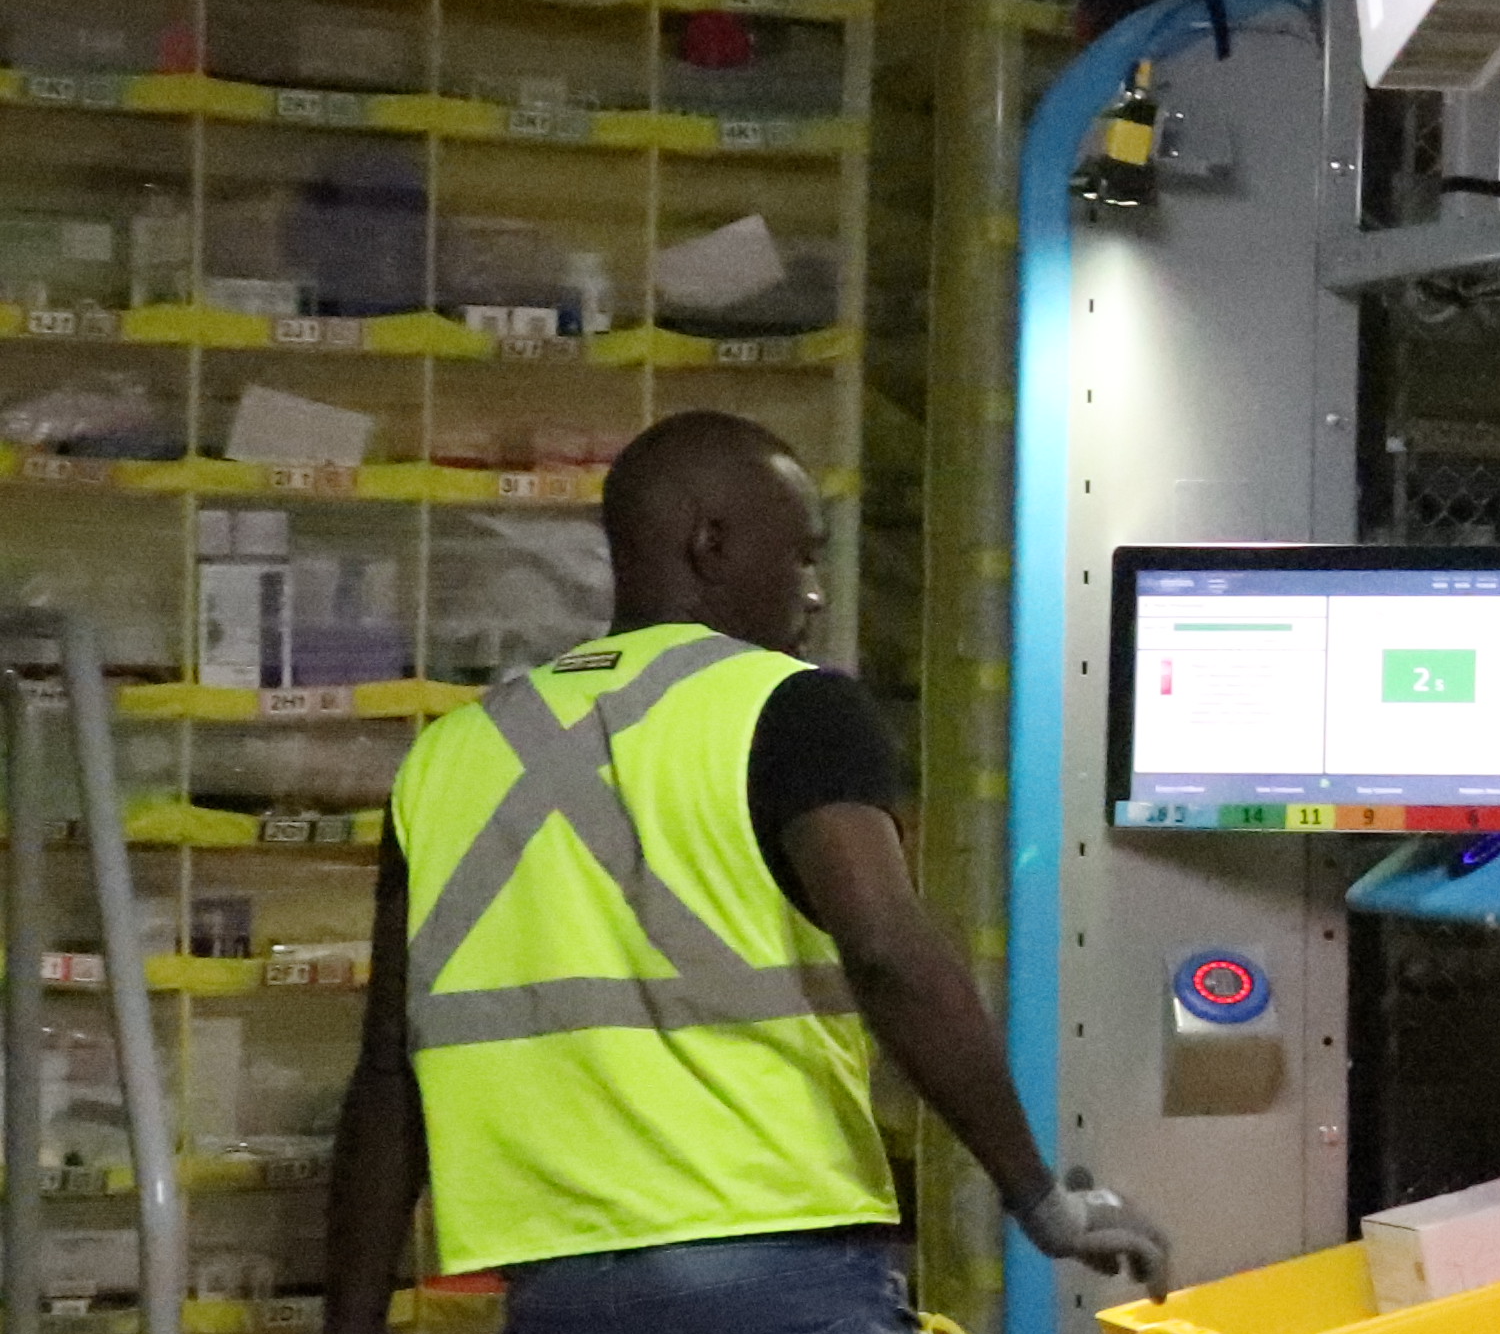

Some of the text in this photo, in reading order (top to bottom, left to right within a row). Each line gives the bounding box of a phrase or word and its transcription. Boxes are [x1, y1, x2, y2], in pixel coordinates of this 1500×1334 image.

[1242, 808, 1263, 825] 14
[1299, 808, 1322, 825] 11
[1363, 808, 1376, 825] 9
